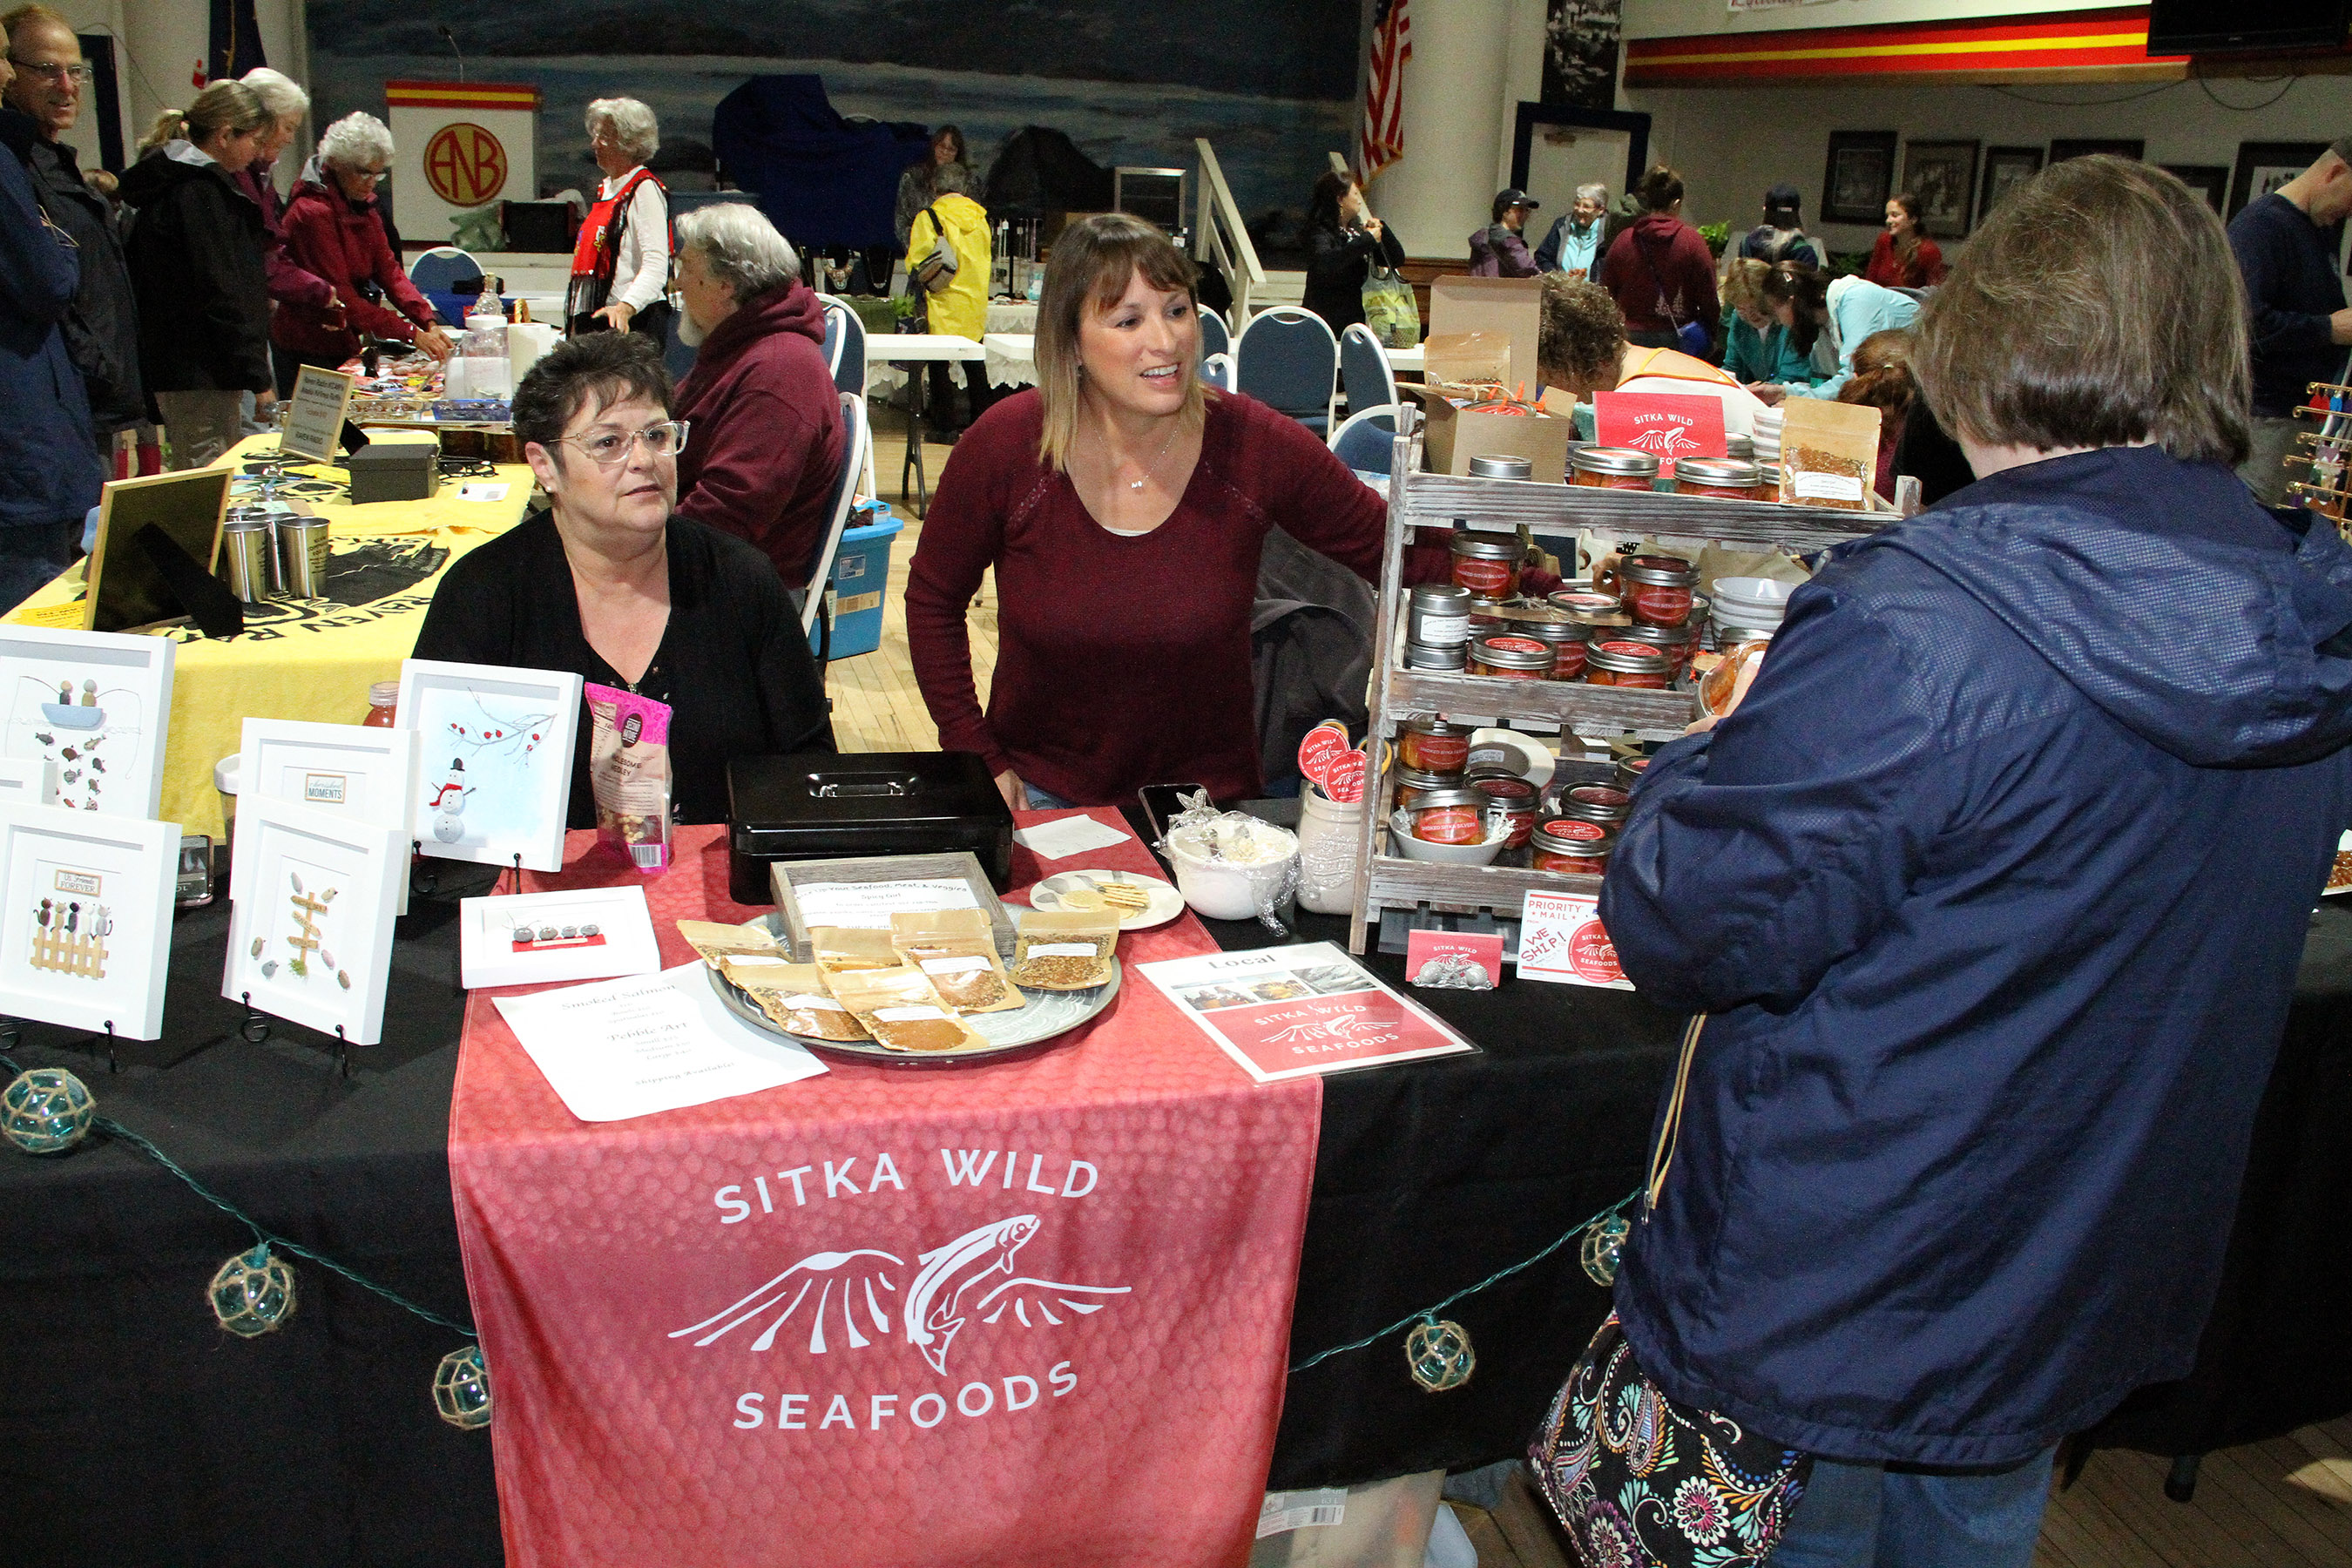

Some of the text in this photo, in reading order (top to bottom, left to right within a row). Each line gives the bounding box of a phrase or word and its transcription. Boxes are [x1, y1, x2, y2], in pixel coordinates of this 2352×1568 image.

[429, 129, 501, 199] ANB
[1634, 413, 1694, 427] SITKA WILD
[300, 595, 432, 632] RAVEN
[1332, 763, 1351, 774] SITKA
[308, 787, 342, 800] MOMENTS
[61, 880, 96, 893] FOREVER
[1528, 900, 1582, 913] PRIORITY
[1539, 911, 1568, 921] MAIL
[1521, 930, 1566, 962] SHIP!
[1524, 927, 1550, 946] WE
[1208, 954, 1276, 969] Local
[1580, 957, 1618, 967] SEAFOODS
[561, 994, 618, 1010] Smoked
[621, 983, 677, 998] Salmon
[1254, 1004, 1367, 1026] SITKA WILD
[606, 1021, 689, 1042] Pebble Art
[1292, 1032, 1399, 1054] SEAFOODS
[634, 1072, 682, 1086] Shipping
[714, 1148, 1099, 1224] SITKA WILD
[733, 1360, 1078, 1431] SEAFOODS
